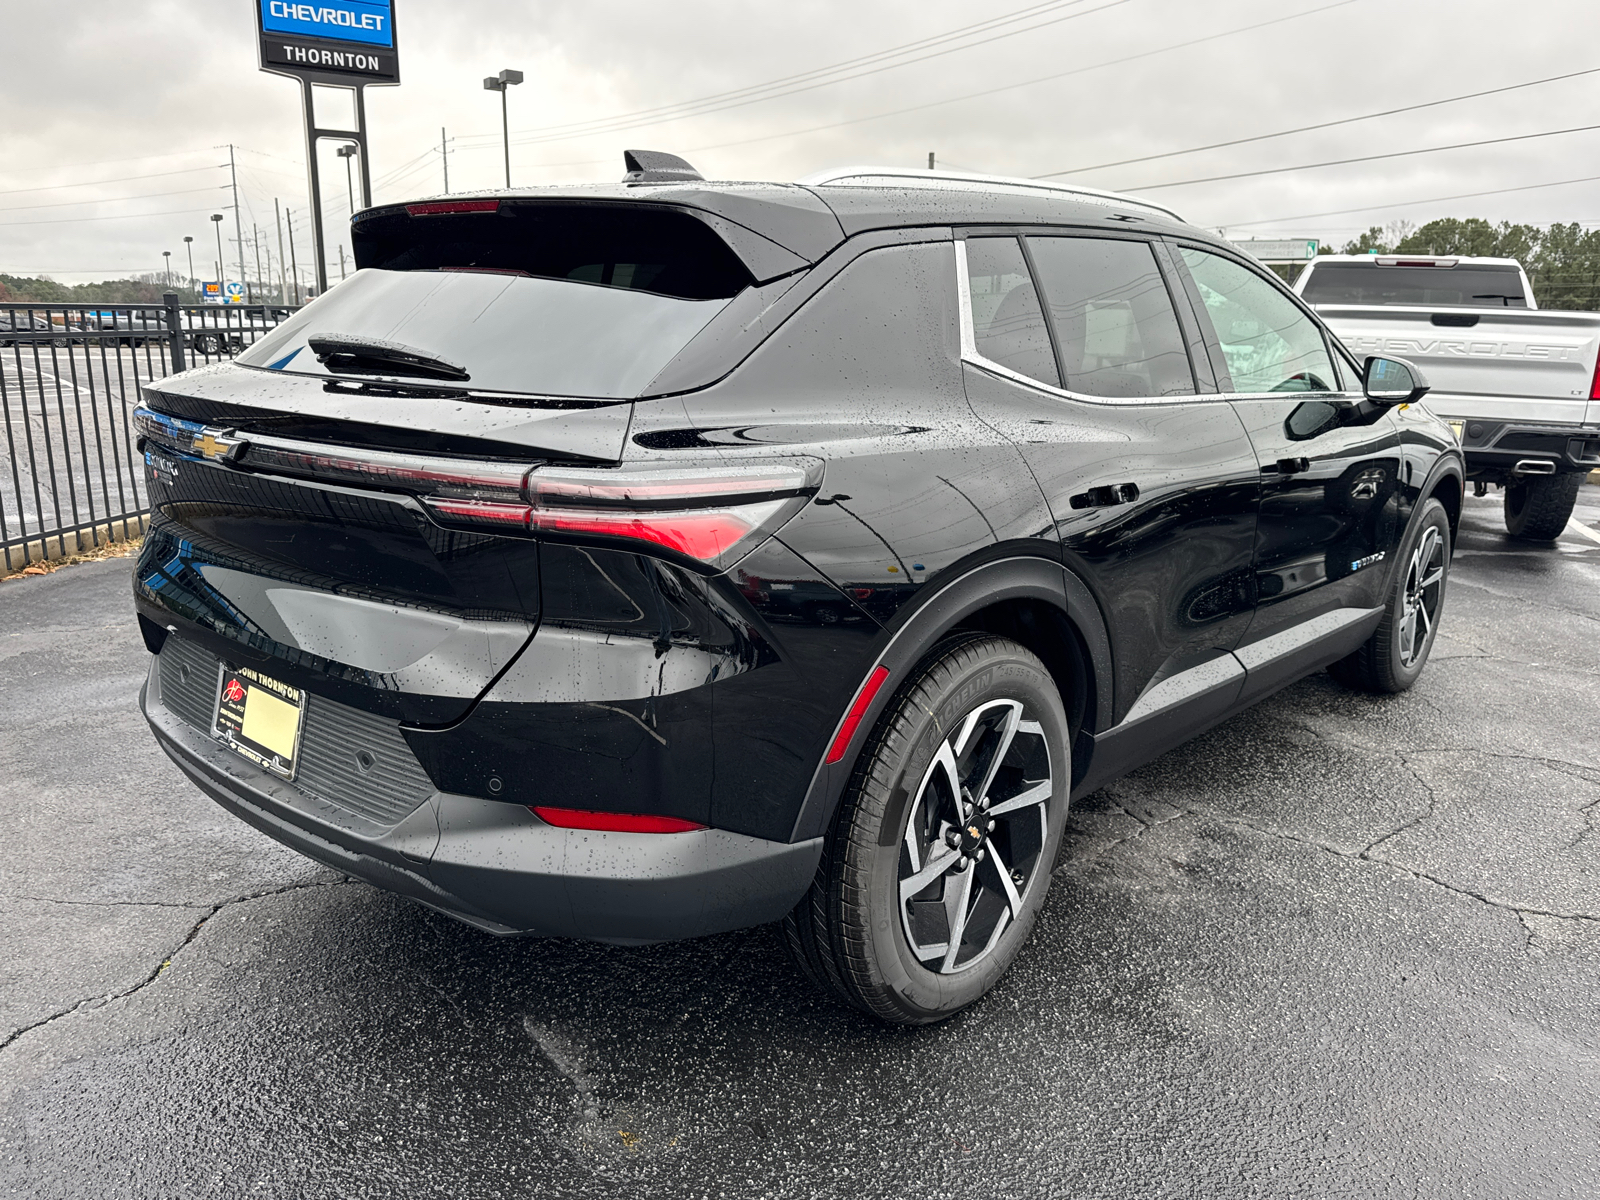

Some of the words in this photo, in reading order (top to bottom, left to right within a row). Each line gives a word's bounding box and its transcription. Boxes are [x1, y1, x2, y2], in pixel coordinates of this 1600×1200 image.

[270, 1, 384, 31] CHEVROLET
[283, 46, 379, 70] THORNTON
[238, 666, 258, 682] OHN
[1000, 666, 1025, 678] 245/55
[928, 672, 991, 745] MICHELIN
